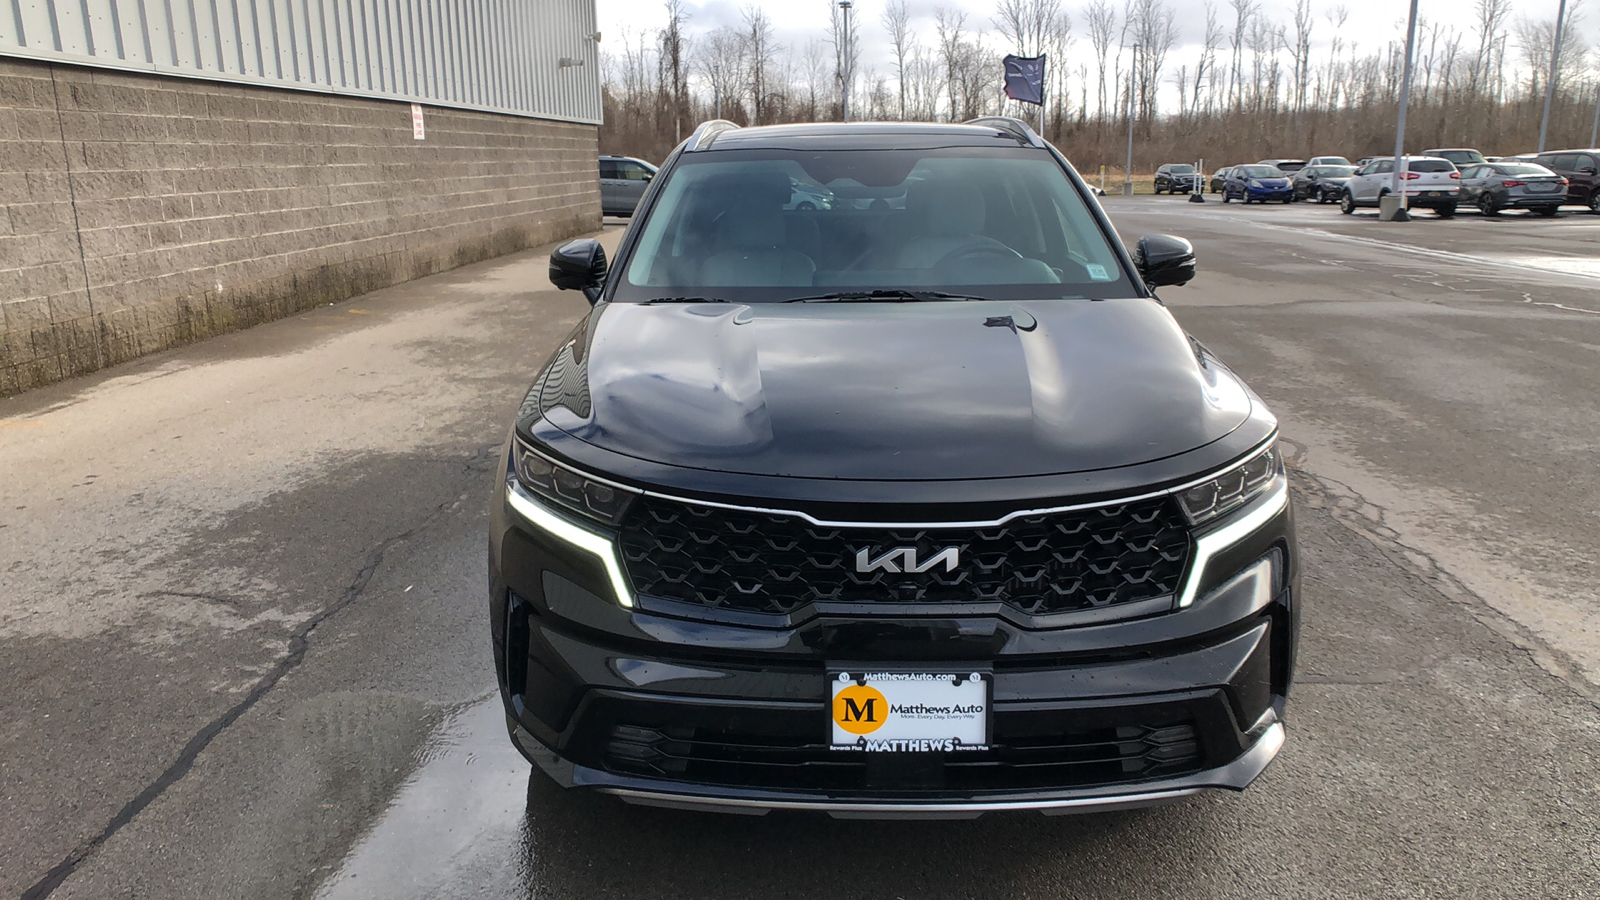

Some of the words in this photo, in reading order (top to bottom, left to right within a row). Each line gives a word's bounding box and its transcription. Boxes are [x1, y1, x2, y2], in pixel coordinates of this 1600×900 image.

[856, 546, 959, 573] KIA
[863, 672, 956, 681] MatthewsAuto.com
[841, 698, 878, 722] M
[890, 703, 951, 714] Matthews
[952, 704, 983, 714] Auto
[865, 739, 953, 752] MATTHEWS
